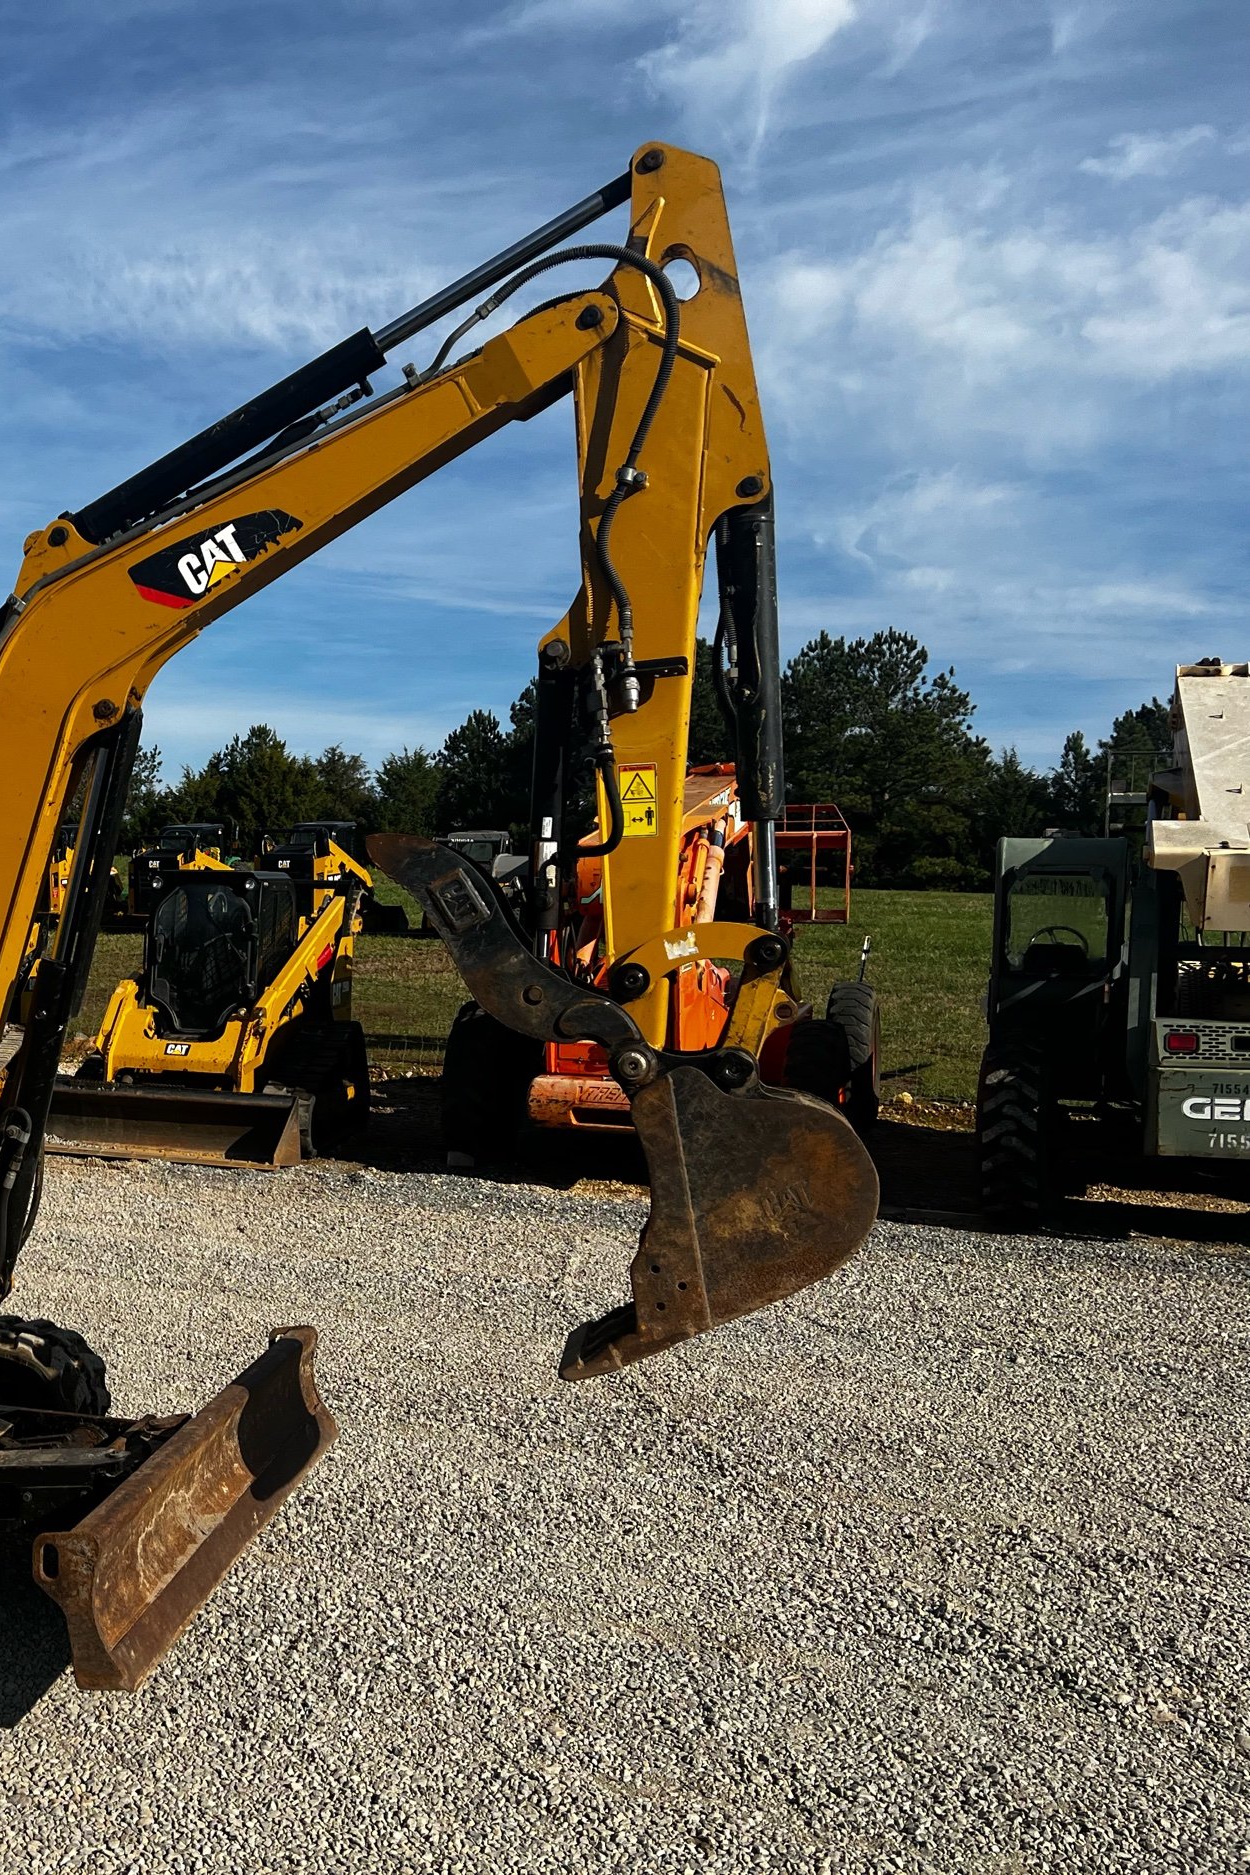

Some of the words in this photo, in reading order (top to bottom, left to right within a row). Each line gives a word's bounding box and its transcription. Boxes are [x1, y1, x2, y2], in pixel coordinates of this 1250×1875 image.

[177, 523, 248, 594] CAT
[149, 860, 160, 868] CAT
[278, 860, 290, 868] CAT
[166, 1044, 189, 1056] CAT
[1182, 1096, 1250, 1121] GE
